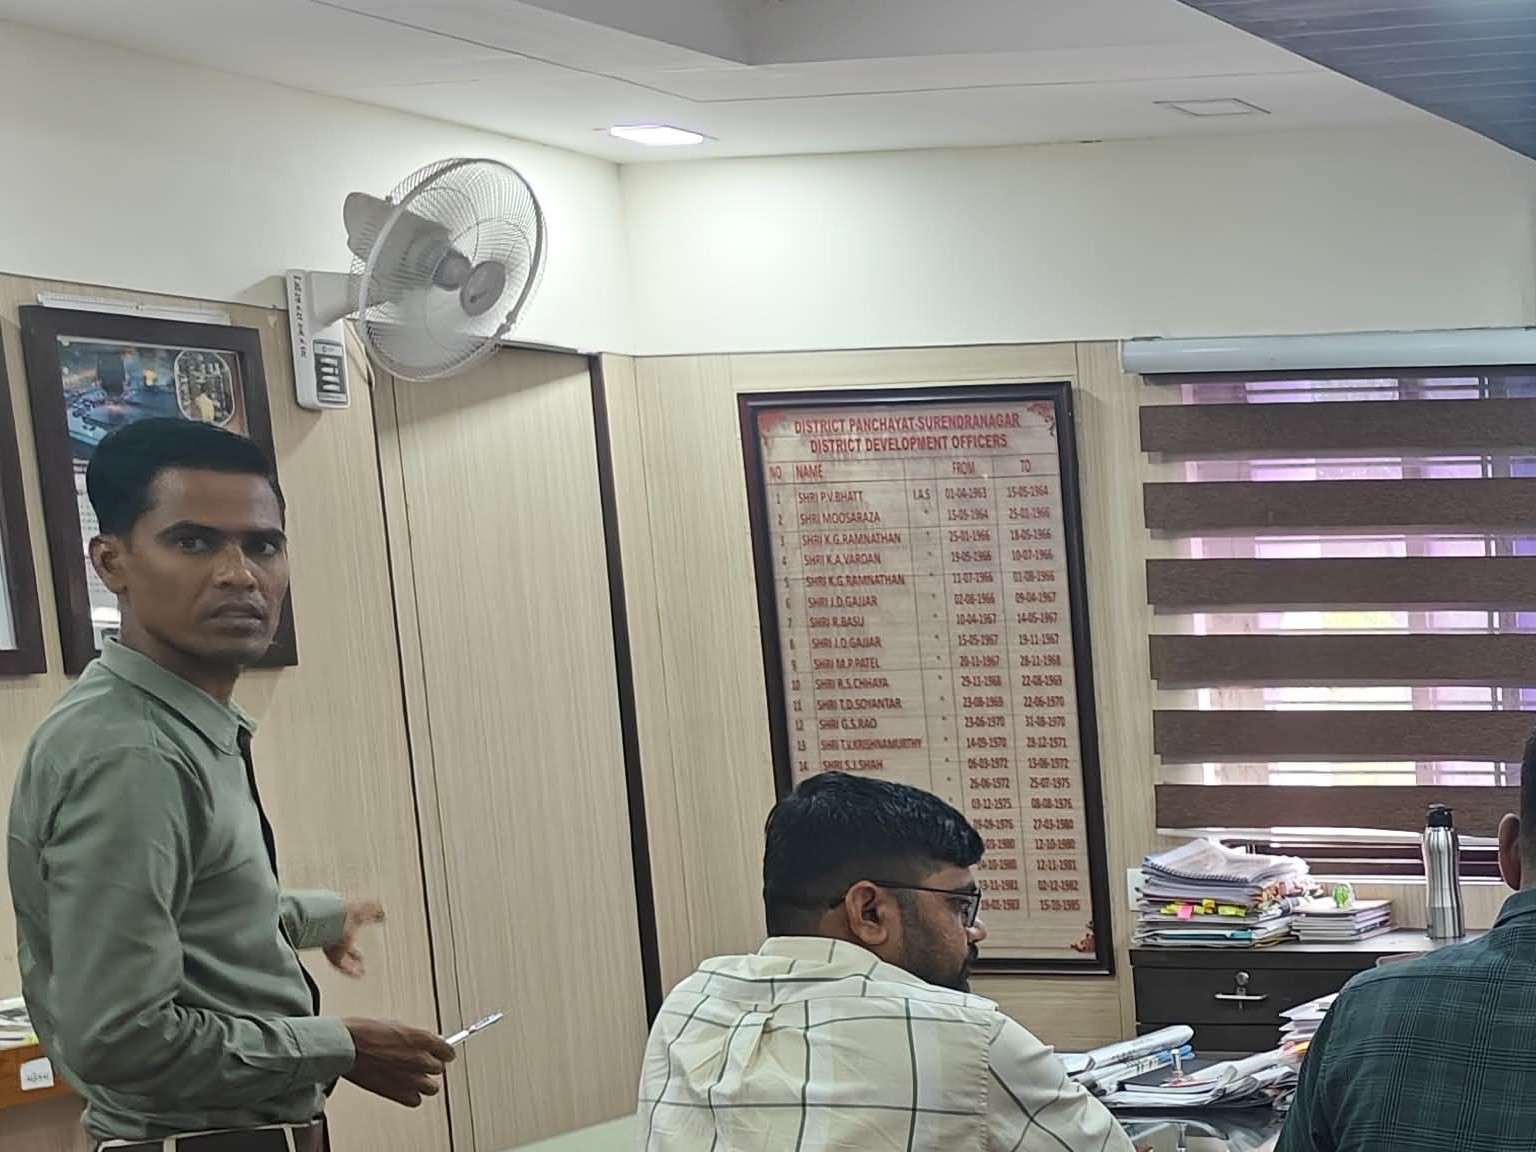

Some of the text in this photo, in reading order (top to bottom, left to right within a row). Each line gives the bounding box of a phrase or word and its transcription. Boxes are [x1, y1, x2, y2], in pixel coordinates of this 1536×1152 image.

[795, 412, 1020, 434] DISTRICT PANCHAYAT-SURENDRANAGAR
[811, 434, 1008, 453] DISTRICT DEVELOPMENT OFFICERS
[769, 460, 1031, 479] NO NAME FROM TO
[799, 492, 817, 504] SHRI
[778, 514, 782, 526] 2
[800, 513, 820, 525] SHRI
[802, 535, 822, 546] SHRI
[804, 555, 824, 565] SHRI
[806, 576, 826, 587] SHRI
[808, 597, 827, 608] SHRI
[810, 617, 830, 628] SHRI
[812, 638, 832, 649] SHRI
[814, 659, 833, 669] SHRI
[816, 679, 835, 689] SHRI
[817, 700, 837, 710] SHRI
[819, 720, 839, 730] SHRI
[821, 740, 839, 750] SHRI
[823, 761, 843, 771] SHRI
